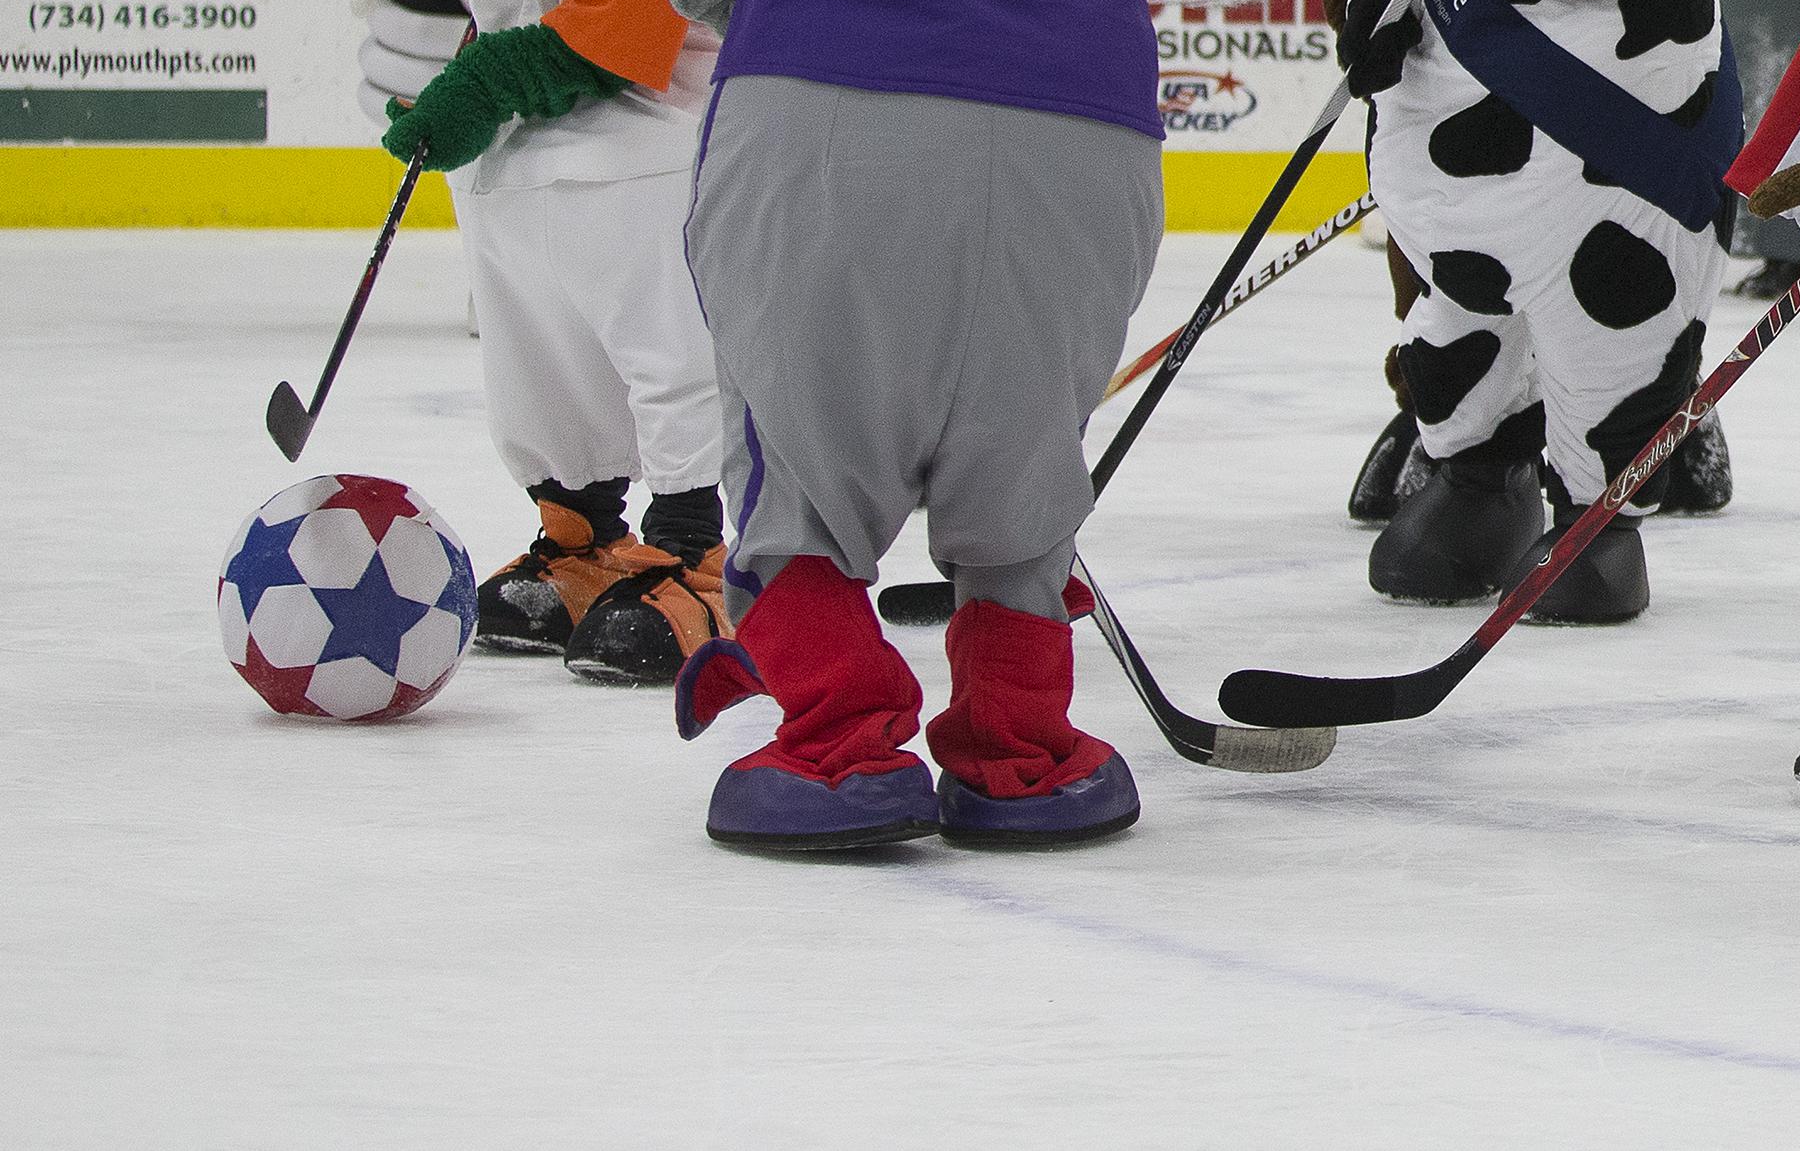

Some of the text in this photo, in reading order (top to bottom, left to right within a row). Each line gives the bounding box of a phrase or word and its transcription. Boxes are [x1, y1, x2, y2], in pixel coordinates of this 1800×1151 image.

[29, 3, 257, 31] (734) 416-3900
[1175, 303, 1210, 359] EASTON
